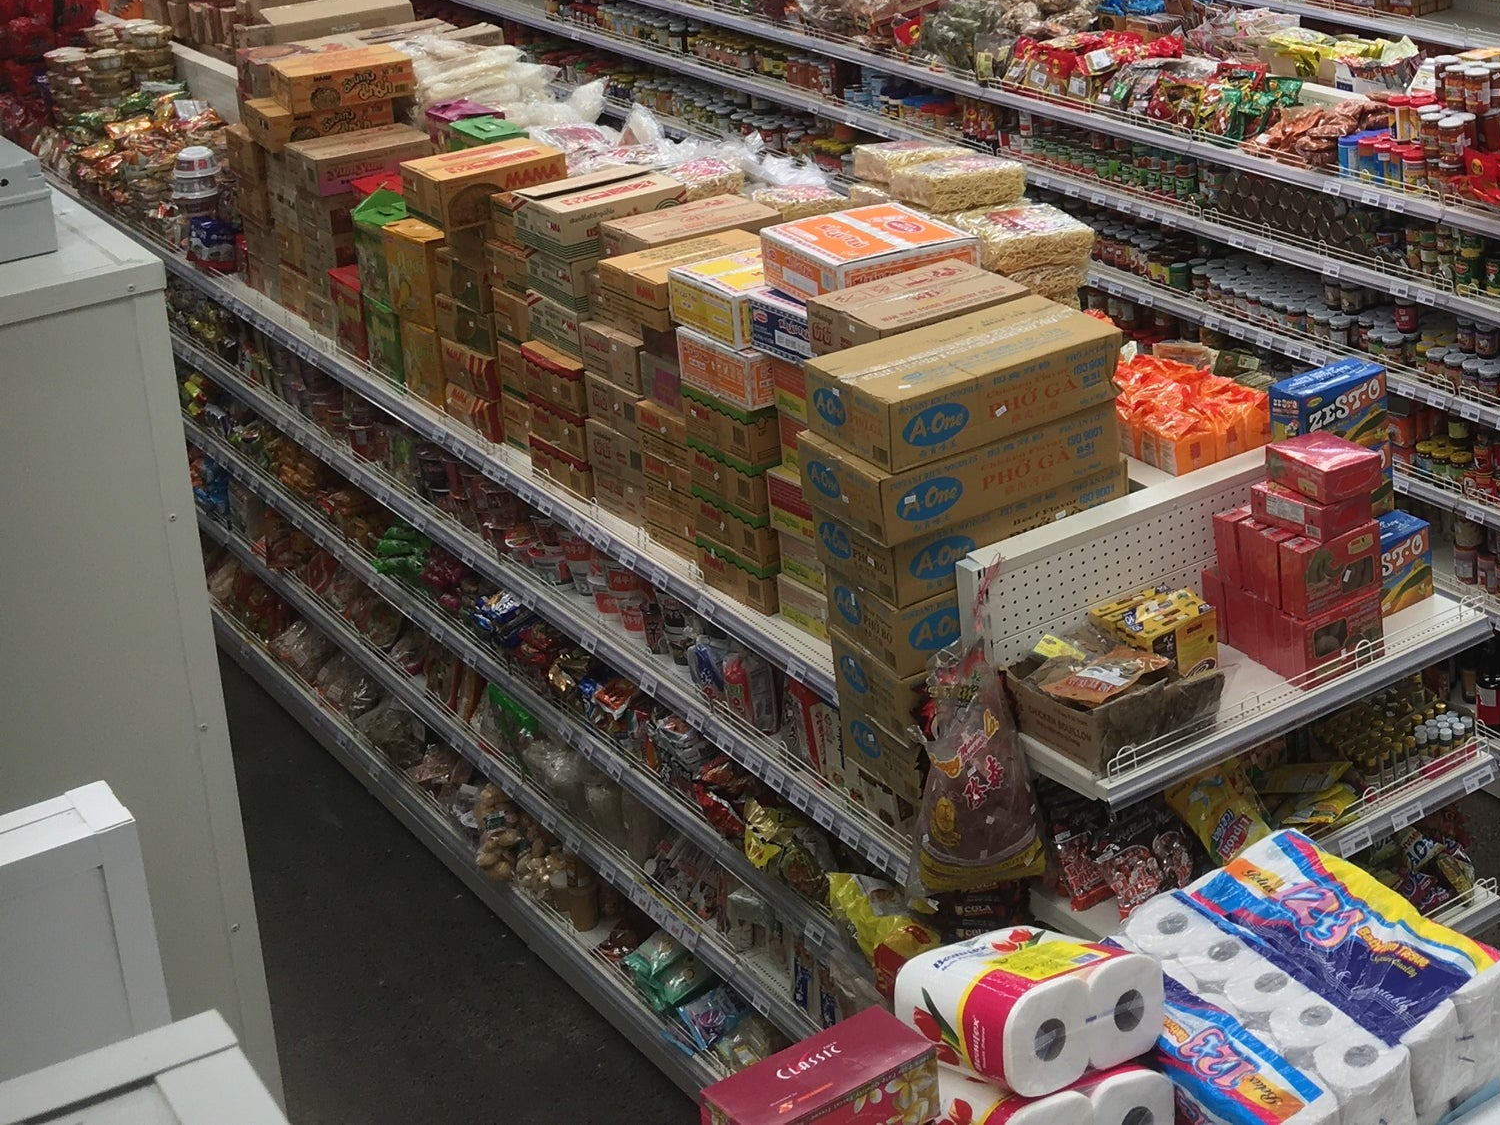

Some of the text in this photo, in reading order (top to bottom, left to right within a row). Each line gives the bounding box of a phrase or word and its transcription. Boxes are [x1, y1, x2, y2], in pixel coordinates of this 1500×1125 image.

[505, 163, 562, 189] MAMA
[909, 410, 964, 444] A-One
[1038, 445, 1072, 470] GÀ
[914, 544, 970, 576] A-One
[1220, 814, 1251, 857] Lipton
[964, 903, 992, 914] COLA
[1276, 879, 1366, 948] 123
[1397, 943, 1431, 970] Tissue
[1179, 1026, 1257, 1086] 123
